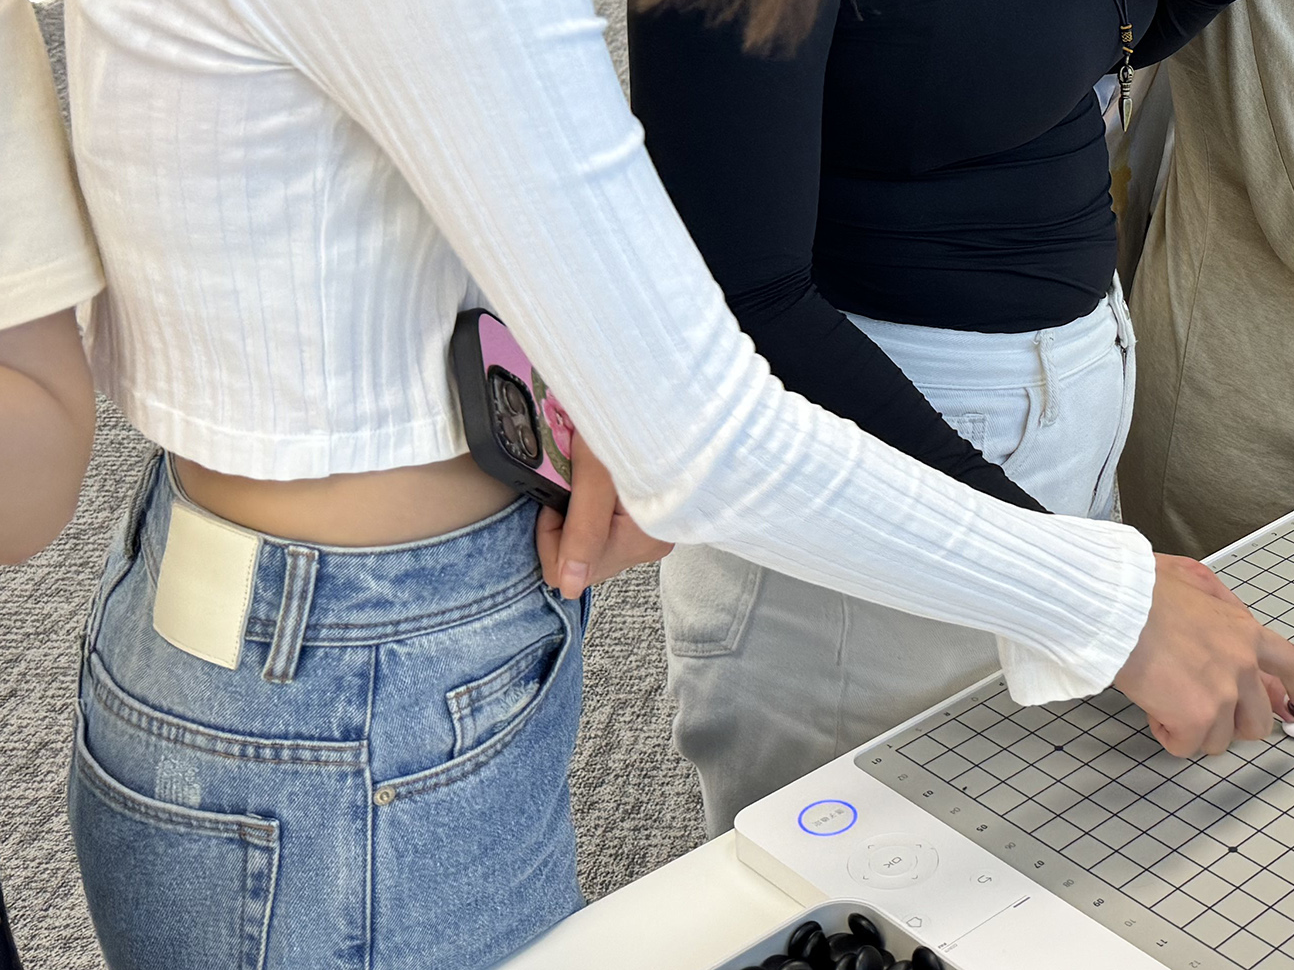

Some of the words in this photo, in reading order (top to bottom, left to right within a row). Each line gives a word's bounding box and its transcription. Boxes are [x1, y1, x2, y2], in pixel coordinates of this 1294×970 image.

[976, 824, 988, 832] 05
[883, 856, 902, 868] OK
[1034, 860, 1045, 869] 07
[1092, 898, 1105, 907] 09
